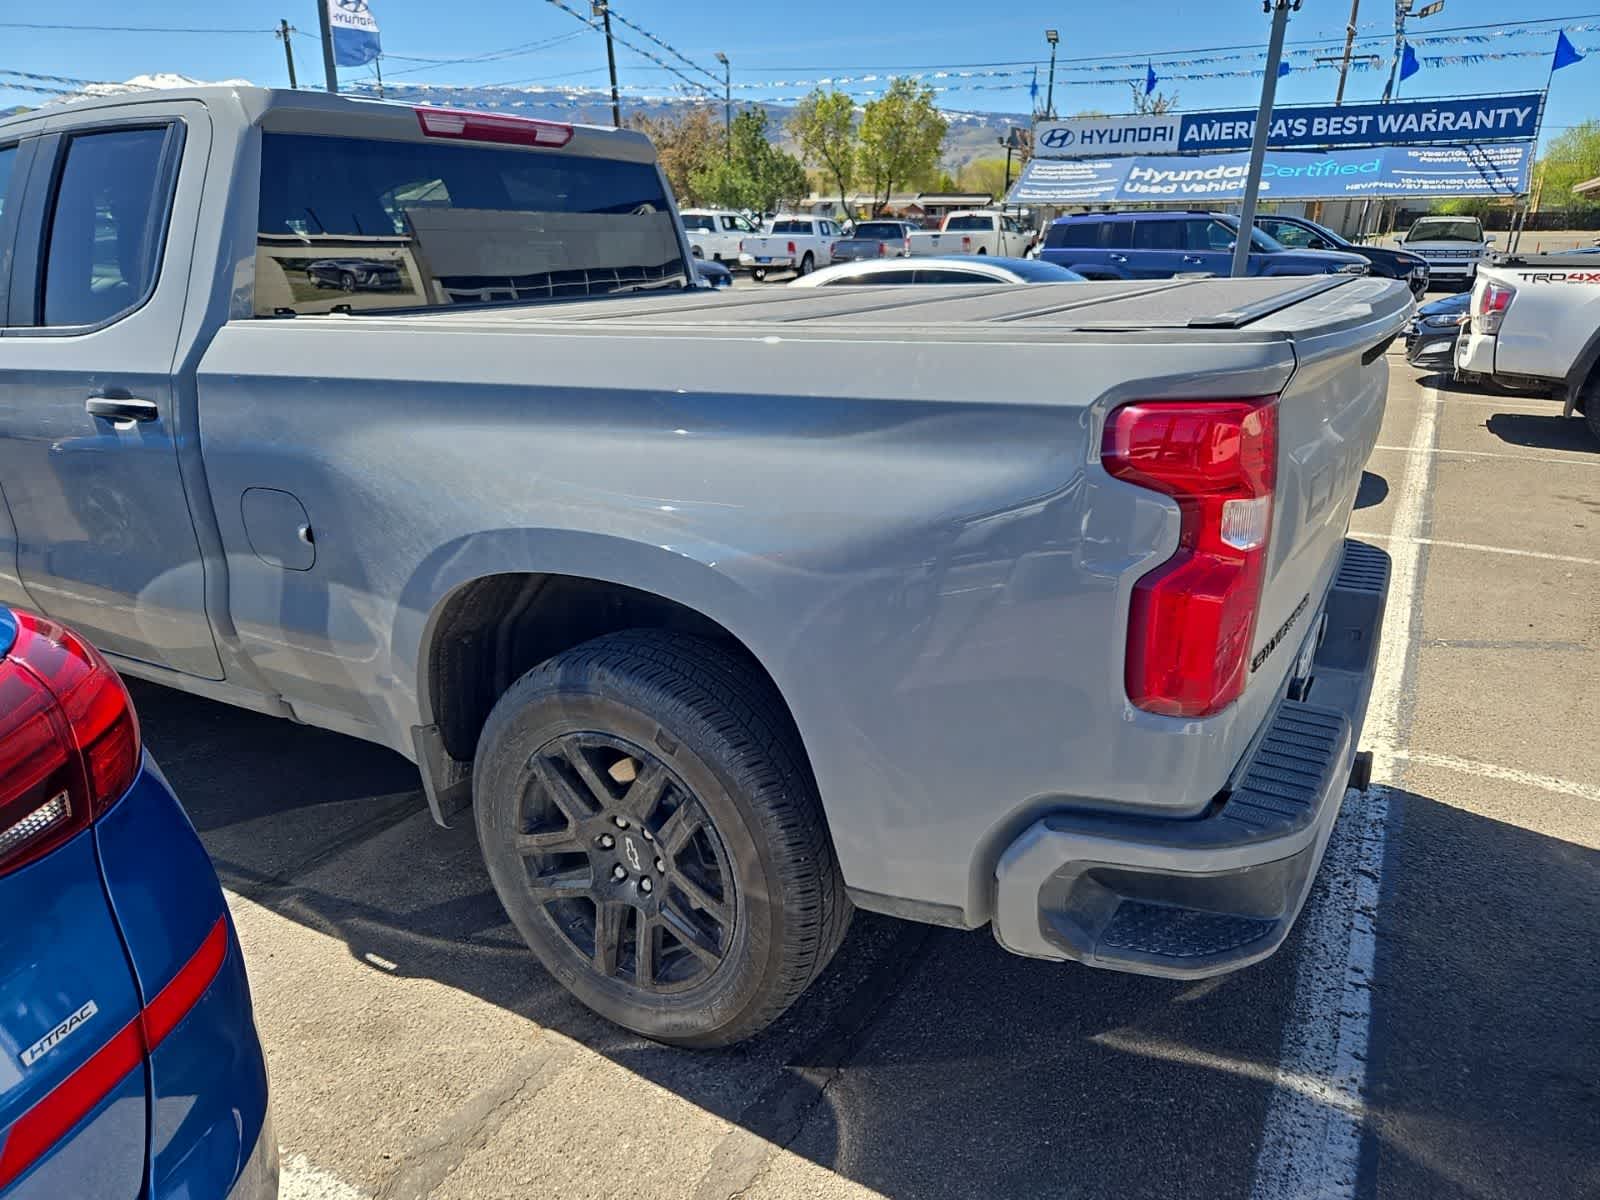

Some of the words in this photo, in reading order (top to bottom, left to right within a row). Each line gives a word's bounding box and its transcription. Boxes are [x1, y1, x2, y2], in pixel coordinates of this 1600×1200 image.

[1081, 126, 1174, 144] HYUNDAI
[1184, 118, 1307, 142] AMERIA'S
[1312, 116, 1373, 136] BEST
[1378, 106, 1532, 133] WARRANTY
[1129, 162, 1251, 183] Hyundai
[1261, 159, 1380, 177] Certified
[1123, 180, 1179, 194] Used
[1181, 178, 1270, 194] Vehicls
[29, 1004, 92, 1060] HTRAC
